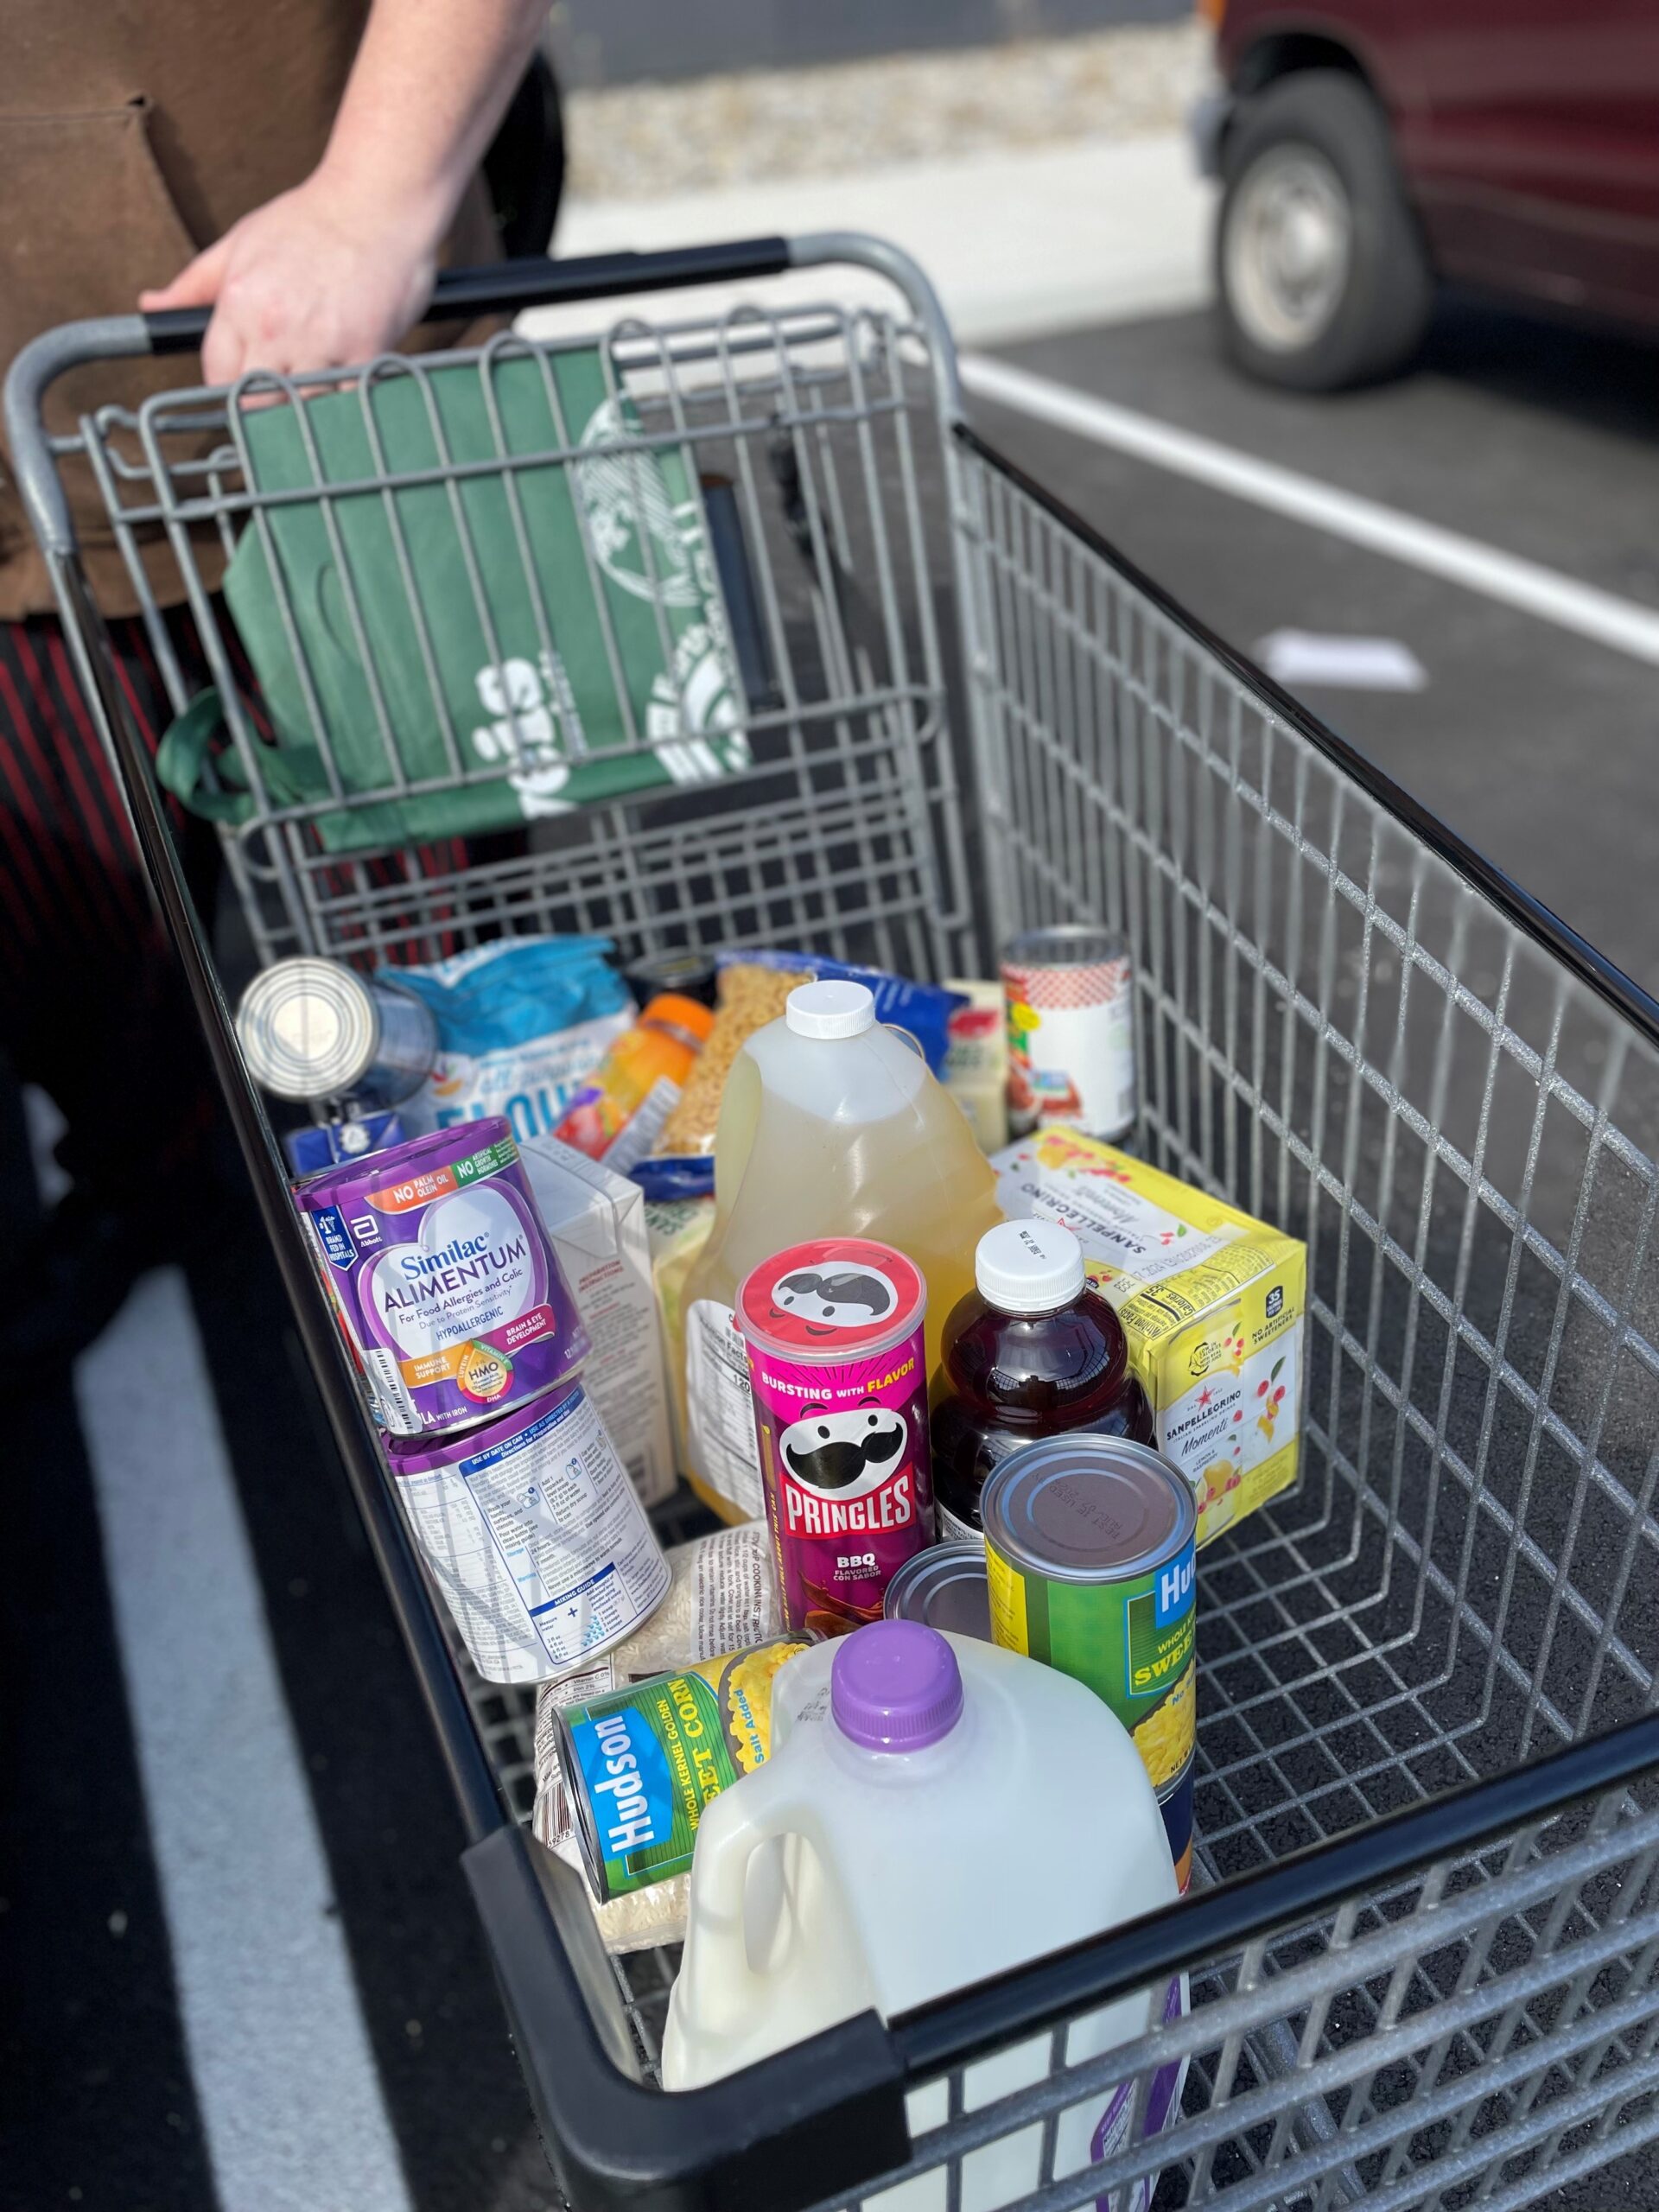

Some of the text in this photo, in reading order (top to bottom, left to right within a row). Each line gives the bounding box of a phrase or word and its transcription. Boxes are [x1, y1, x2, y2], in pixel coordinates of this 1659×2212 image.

[456, 1160, 474, 1179] NO
[472, 1148, 492, 1161] ARTIFICIAL
[475, 1155, 492, 1168] GROWTH
[477, 1160, 499, 1175] HORMONES
[393, 1174, 448, 1204] NO PALM OIL
[416, 1183, 437, 1198] OLEIN
[1021, 1182, 1147, 1254] SANPELLEGRINO
[360, 1236, 383, 1247] Abbott
[398, 1268, 523, 1325] For Food Allergies and Colic
[1147, 1285, 1193, 1317] Calories 35
[1268, 1288, 1280, 1304] 35
[419, 1319, 436, 1330] Due
[436, 1314, 446, 1324] to
[447, 1304, 474, 1320] Protein
[435, 1306, 504, 1341] HYPOALLERGENIC
[505, 1312, 543, 1337] BRAIN & EYE
[1252, 1307, 1294, 1339] NO ARTIFICIAL
[1253, 1314, 1294, 1345] SWEETENERS
[506, 1319, 547, 1345] DEVELOPMENT
[413, 1356, 447, 1371] IMMUNE
[480, 1344, 504, 1359] VITAMIN
[1199, 1344, 1221, 1360] CALORIES
[415, 1363, 451, 1379] SUPPORT
[458, 1354, 469, 1379] LUTEIN
[468, 1361, 499, 1382] HMO
[761, 1357, 915, 1400] BURSTING WITH FLAVOR
[733, 1375, 751, 1393] 120
[486, 1394, 501, 1403] DHA
[436, 1406, 467, 1421] WITH IRON
[1166, 1390, 1242, 1441] SANPELLEGRINO
[1173, 1402, 1236, 1444] ITALIAN SPARKLING DRINKS
[482, 1452, 491, 1461] BY
[491, 1446, 505, 1457] DATE
[512, 1436, 524, 1446] CAN
[500, 1441, 526, 1458] Directions
[533, 1420, 557, 1440] Preparation
[1181, 1418, 1230, 1458] Momenti
[1192, 1452, 1218, 1472] RASPBERRY
[1195, 1452, 1211, 1465] LEMON
[785, 1477, 912, 1535] PRINGLES
[833, 1565, 880, 1576] FLAVORED
[836, 1553, 876, 1568] BBQ
[854, 1569, 882, 1580] SABOR
[554, 1579, 595, 1606] MIXING GUIDE
[1158, 1625, 1186, 1654] WHOLE
[1135, 1626, 1195, 1687] SWEE
[1172, 1690, 1185, 1707] No
[733, 1688, 765, 1764] Salt Added
[667, 1678, 721, 1806] EET CORN
[656, 1700, 699, 1831] WHOLE KERNEL GOLDEN
[1170, 1757, 1183, 1773] NET
[594, 1715, 654, 1854] Hudson
